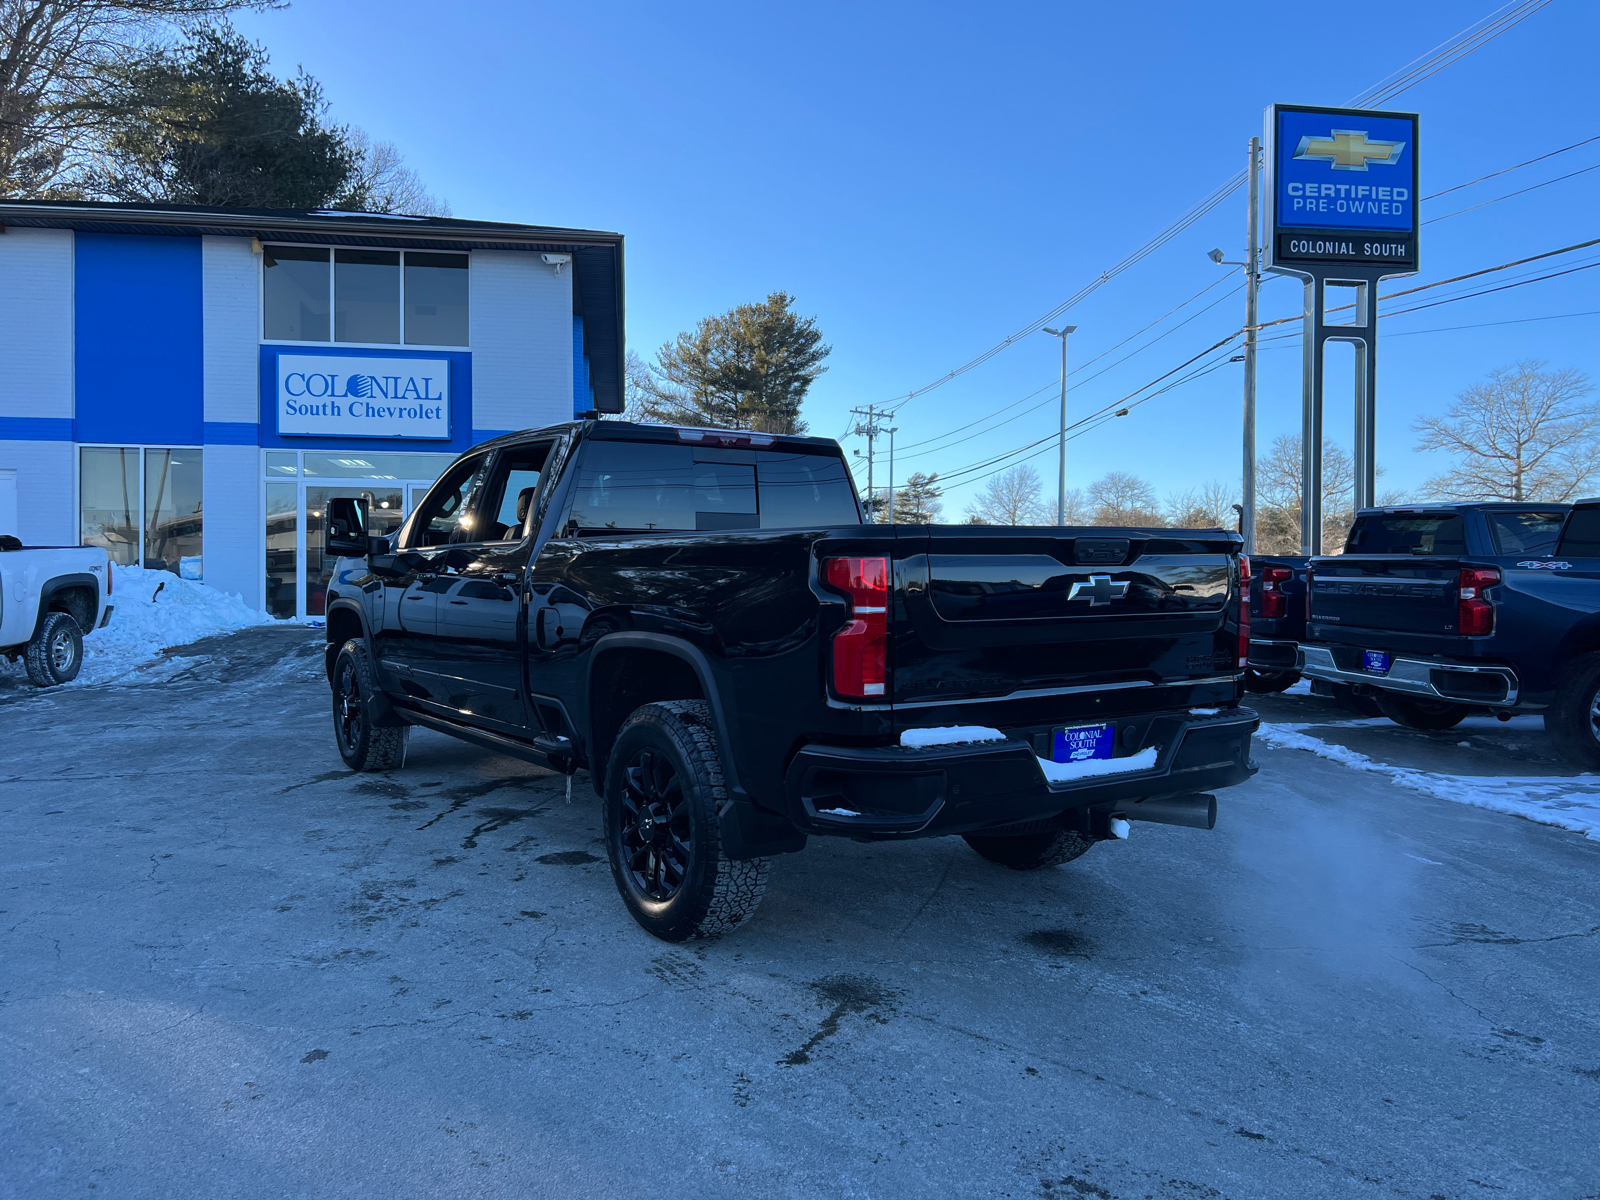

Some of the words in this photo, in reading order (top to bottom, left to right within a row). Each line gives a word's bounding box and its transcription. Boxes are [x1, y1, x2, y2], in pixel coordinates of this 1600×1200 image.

[1287, 182, 1408, 201] CERTIFIED
[1293, 199, 1403, 215] PRE-OWNED
[1290, 239, 1356, 255] COLONIAL
[1364, 242, 1406, 257] SOUTH
[284, 372, 443, 401] COLONIAL
[285, 399, 342, 417] South
[348, 401, 443, 420] Chevrolet
[1313, 582, 1445, 599] CHEVROLET
[1065, 730, 1102, 741] COLONIAL
[1070, 739, 1096, 749] SOUTH
